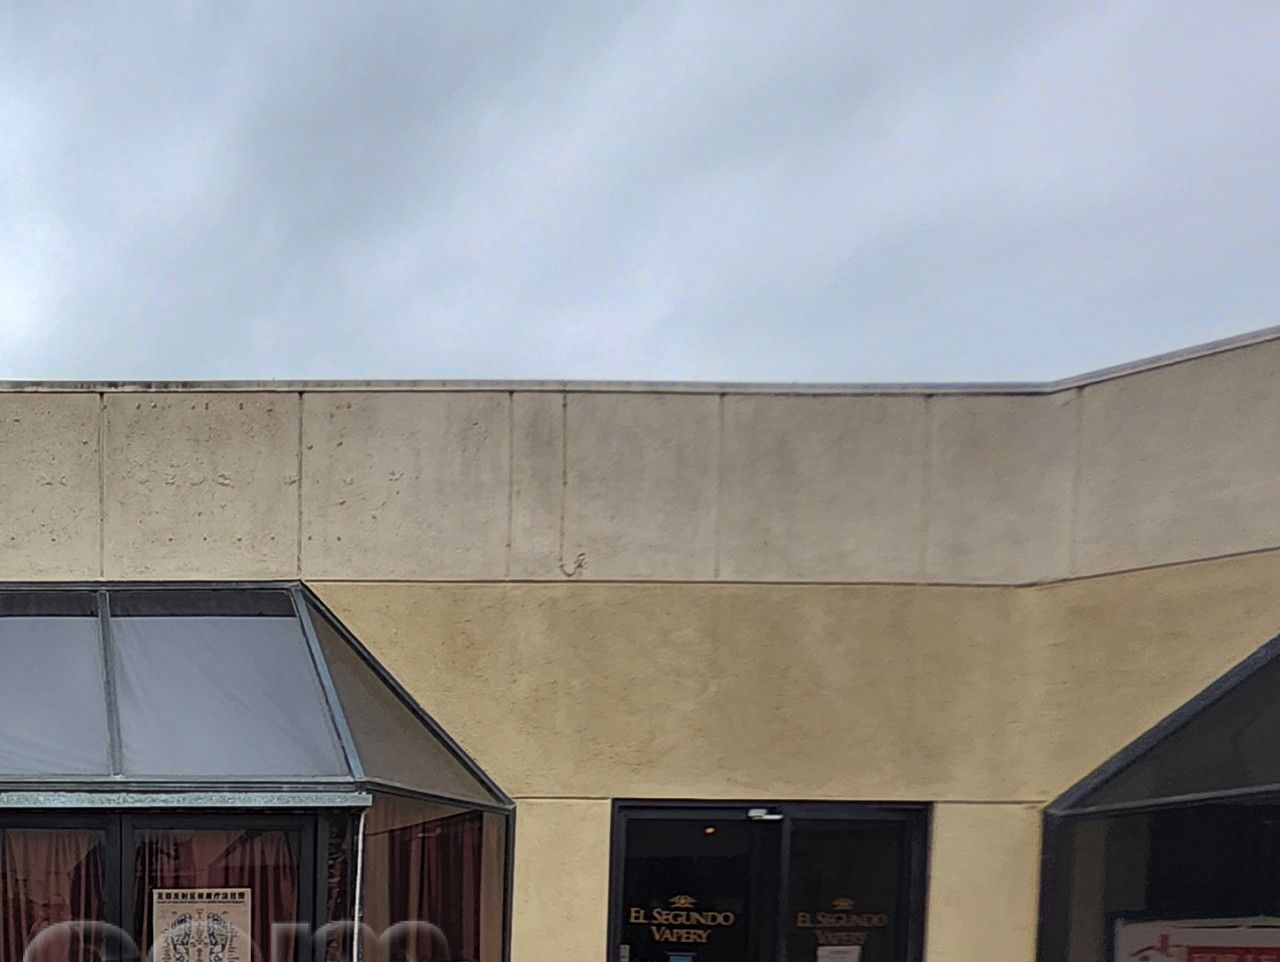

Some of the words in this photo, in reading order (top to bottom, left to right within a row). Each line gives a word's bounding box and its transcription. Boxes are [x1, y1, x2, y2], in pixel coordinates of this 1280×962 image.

[628, 907, 649, 924] EL
[652, 907, 736, 926] SEGUNDO
[650, 926, 713, 943] VAPERY
